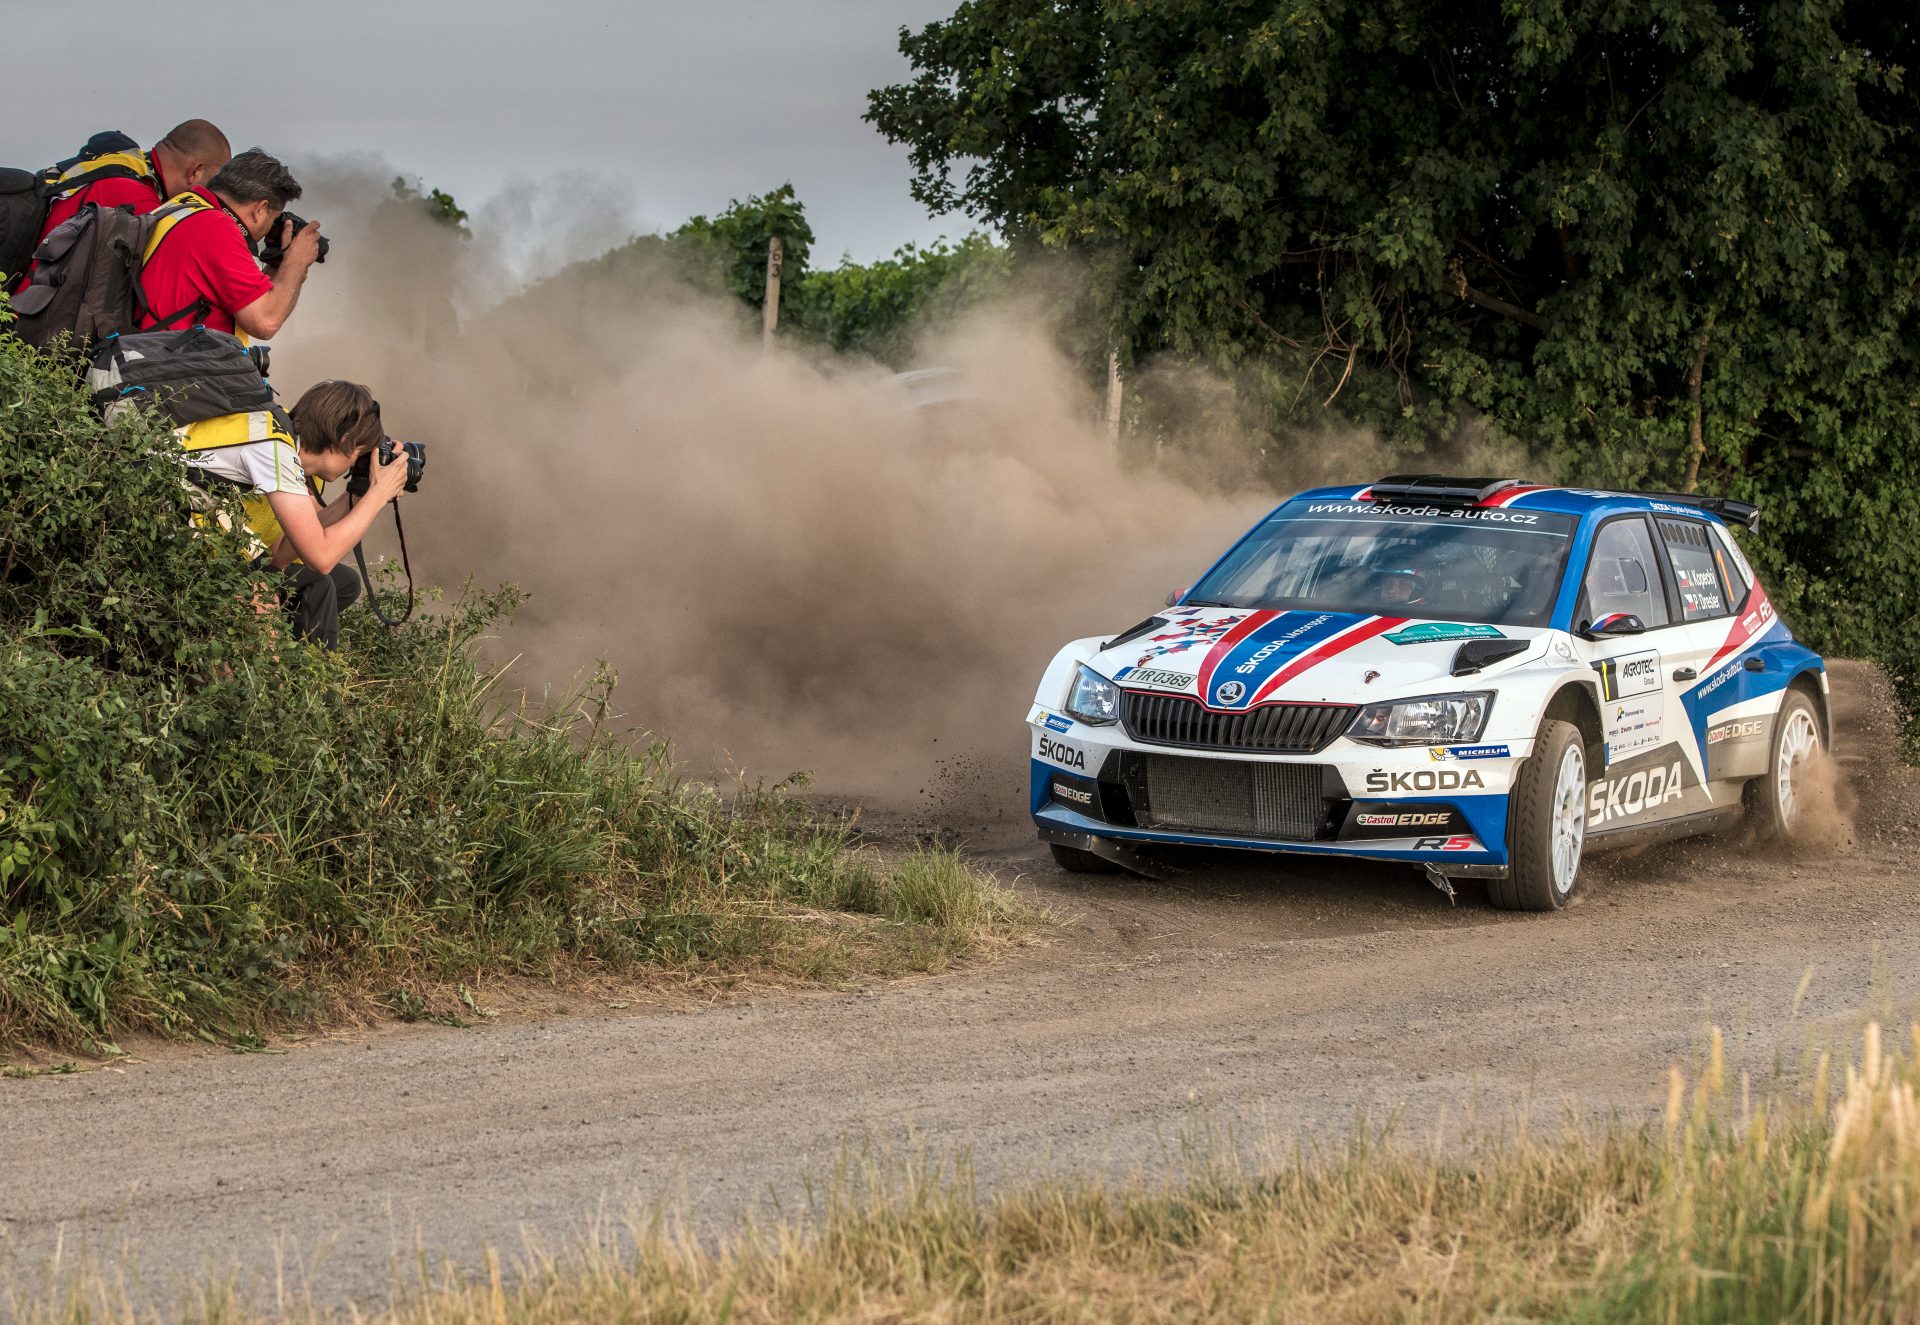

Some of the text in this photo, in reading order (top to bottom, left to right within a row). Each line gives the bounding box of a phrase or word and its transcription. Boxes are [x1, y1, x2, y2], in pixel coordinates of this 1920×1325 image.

[1308, 503, 1539, 525] www.skoda-auto.cz
[1716, 549, 1735, 602] 1
[1235, 640, 1290, 673] ŠKODA
[1623, 659, 1654, 678] AGROTEC
[1725, 721, 1763, 739] EDGE
[1038, 733, 1085, 770] ŠKODA
[1458, 747, 1508, 756] MICHELIN
[1366, 768, 1485, 793] ŠKODA
[1067, 788, 1093, 805] EDGE
[1588, 761, 1682, 827] ŠKODA
[1366, 812, 1452, 825] Castrol EDGE
[1412, 837, 1474, 850] R5
